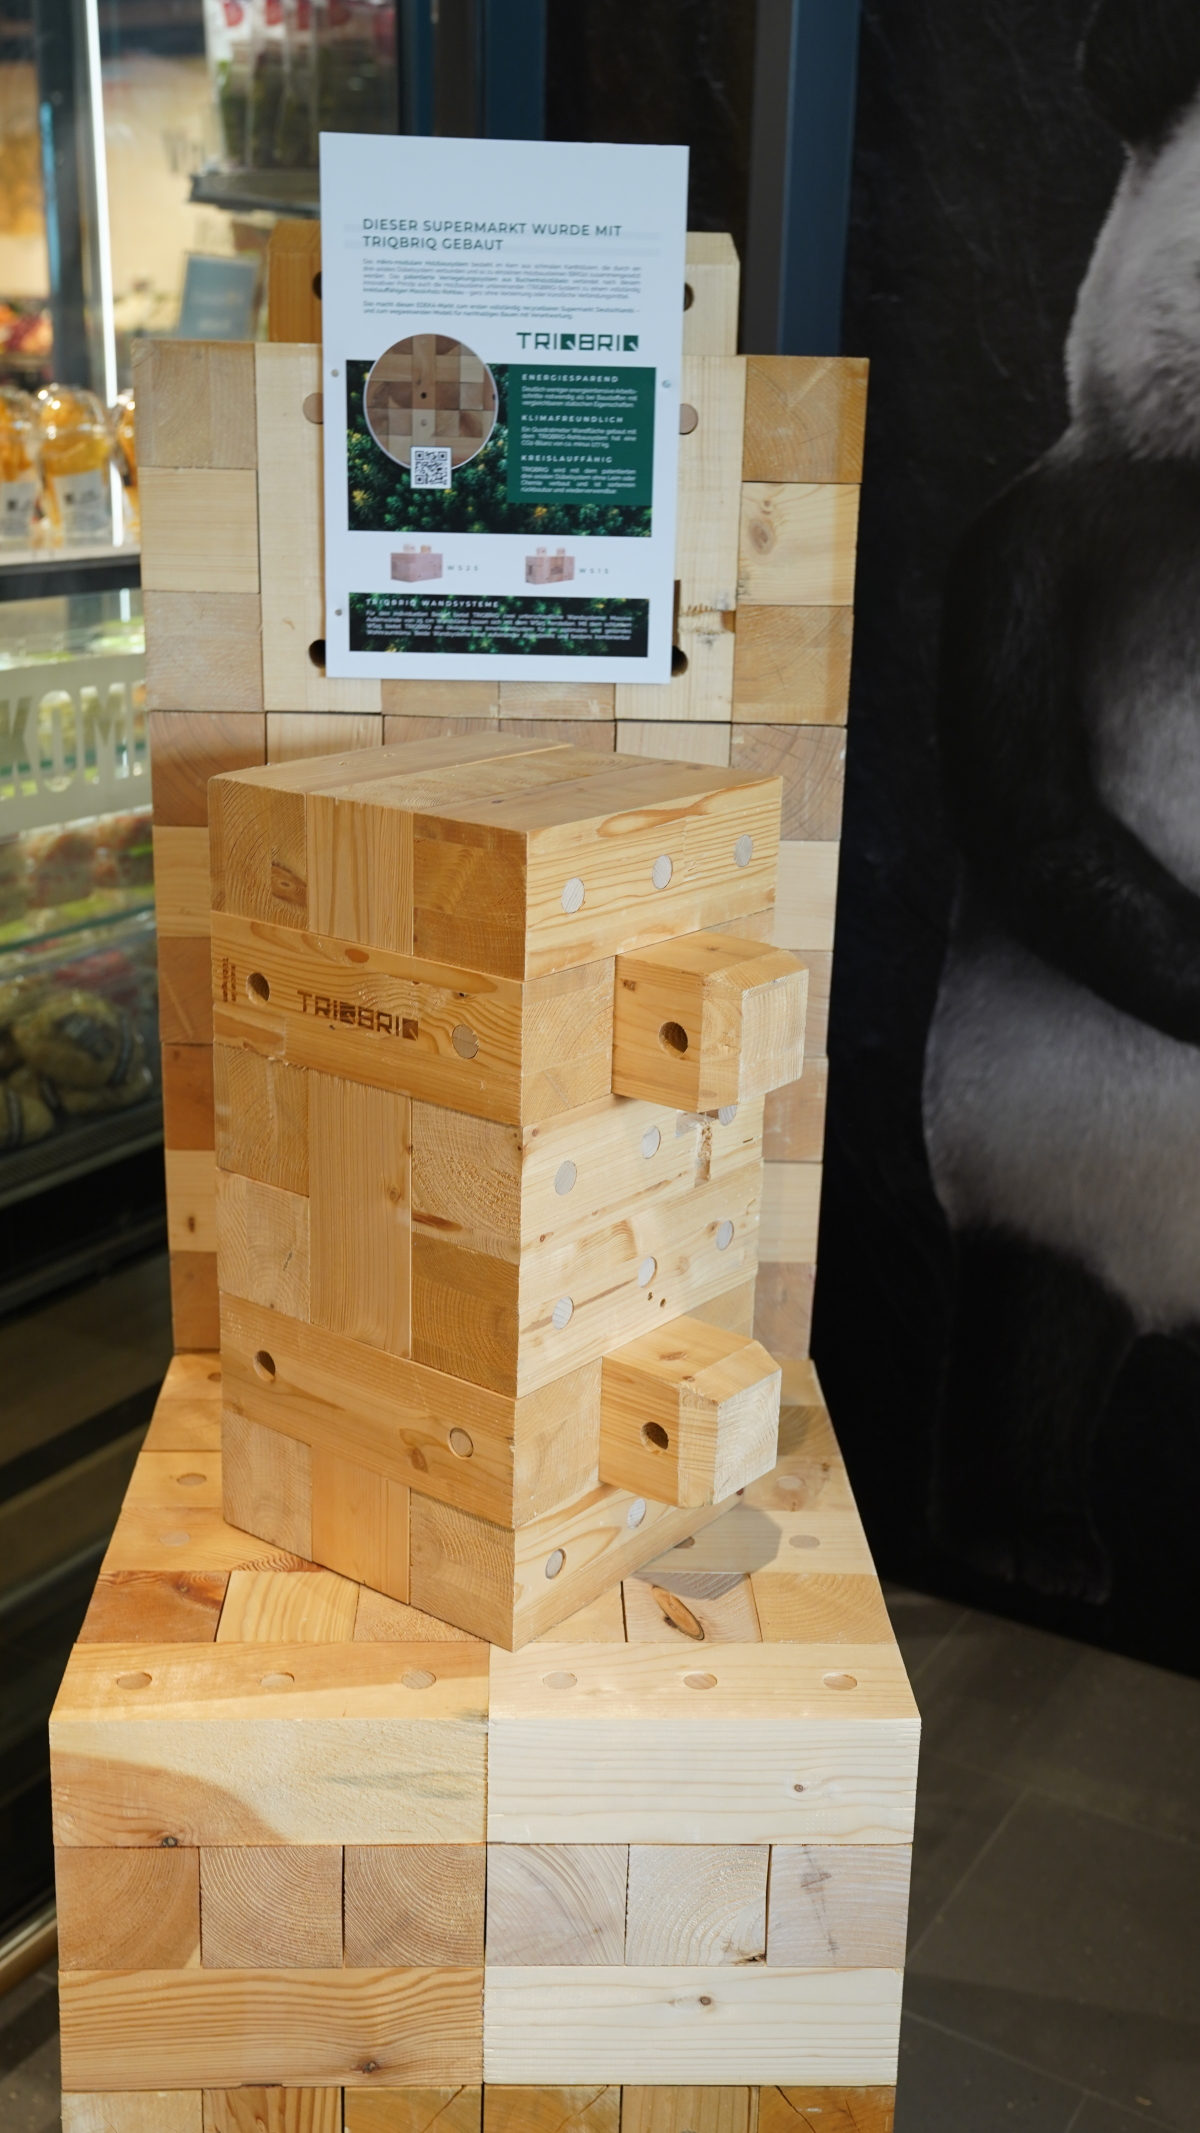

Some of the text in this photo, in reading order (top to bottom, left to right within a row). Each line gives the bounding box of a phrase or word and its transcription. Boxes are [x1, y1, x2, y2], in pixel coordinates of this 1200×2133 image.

[363, 218, 622, 237] DIESER SUPERMARKT WURDE MIT
[363, 236, 504, 250] TRIQBRIQ GEBAUT
[517, 332, 640, 352] TRIQBRIQ
[521, 374, 619, 382] ENERGIESPAREND
[521, 414, 623, 423] KLIMAFREUNDLICH
[521, 454, 612, 463] KREISLAUFFÄHIG
[421, 599, 498, 608] WANDSYSTEME
[296, 990, 418, 1041] TRIQBRIQ
